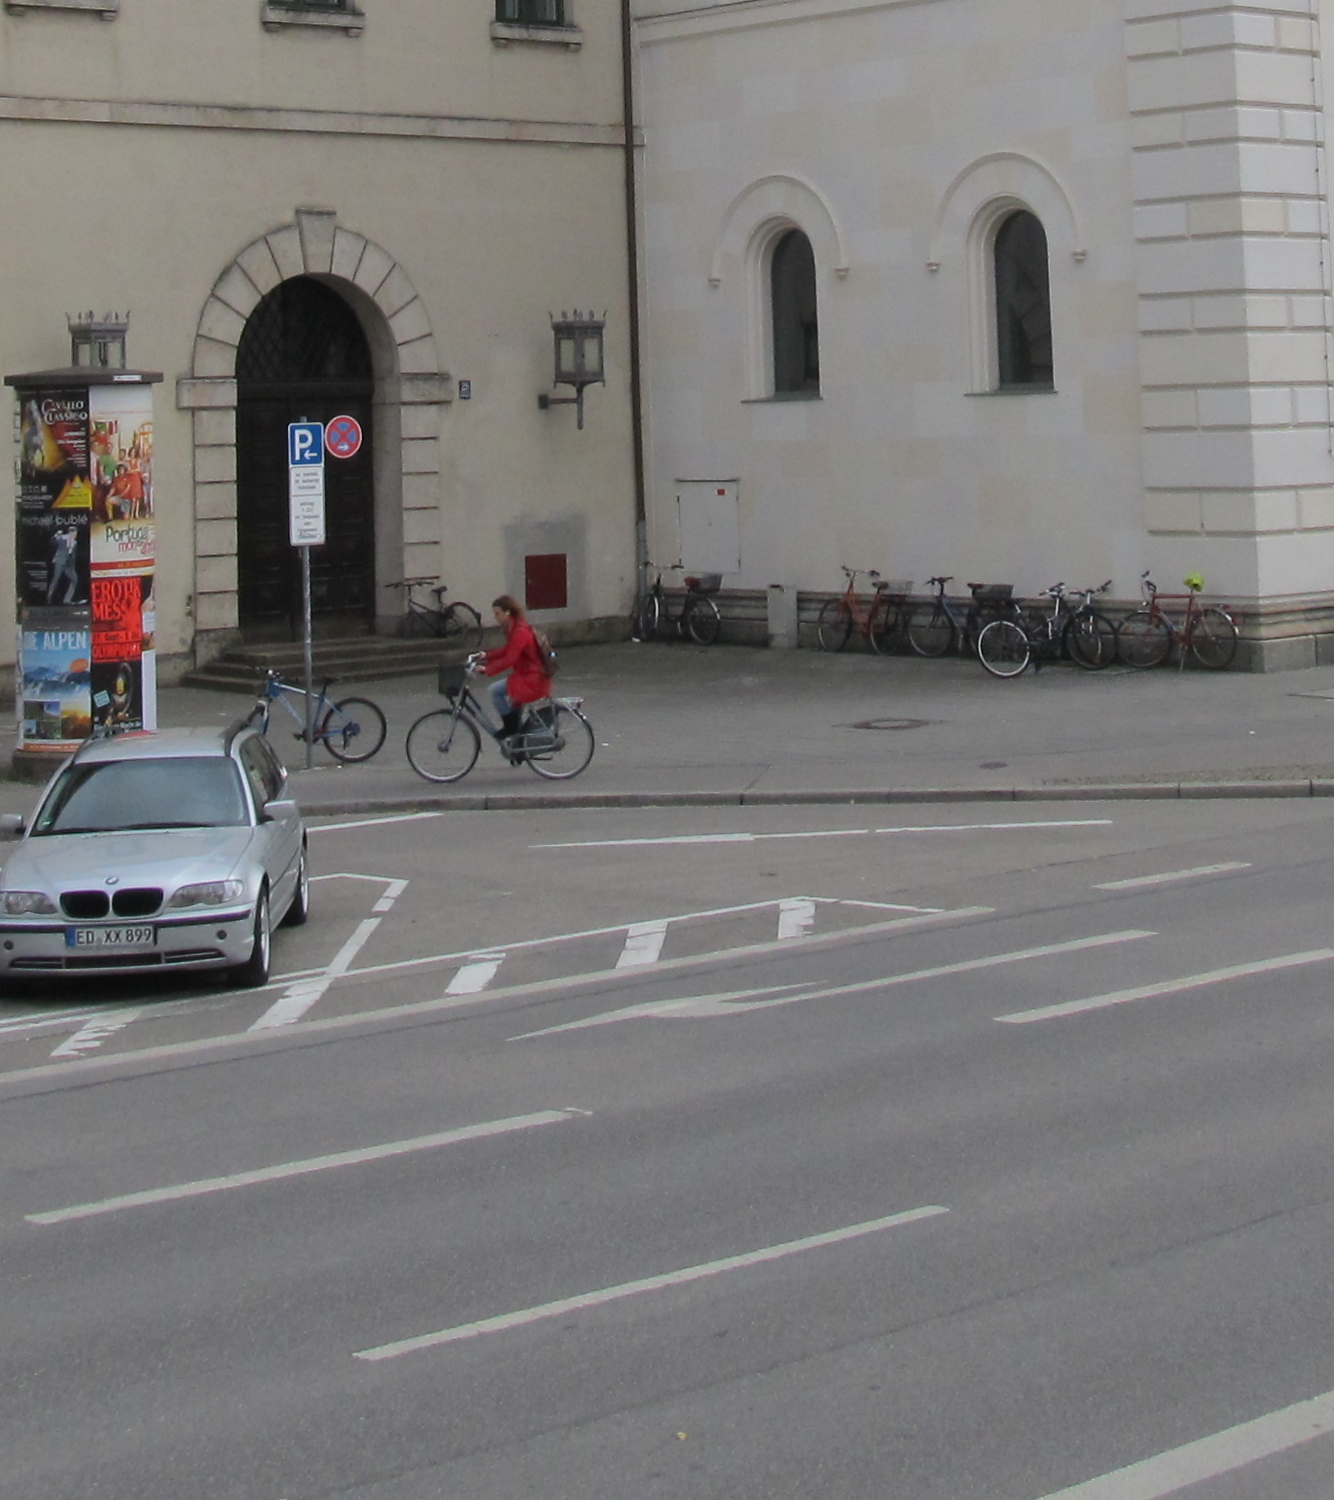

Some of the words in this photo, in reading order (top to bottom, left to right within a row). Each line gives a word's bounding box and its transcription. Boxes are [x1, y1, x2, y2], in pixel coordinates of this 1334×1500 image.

[295, 429, 313, 461] P
[92, 578, 141, 603] EROTIK
[24, 631, 37, 651] DIE
[43, 630, 87, 651] ALPEN
[76, 930, 94, 945] ED
[104, 929, 122, 944] XX
[125, 927, 152, 943] 899
